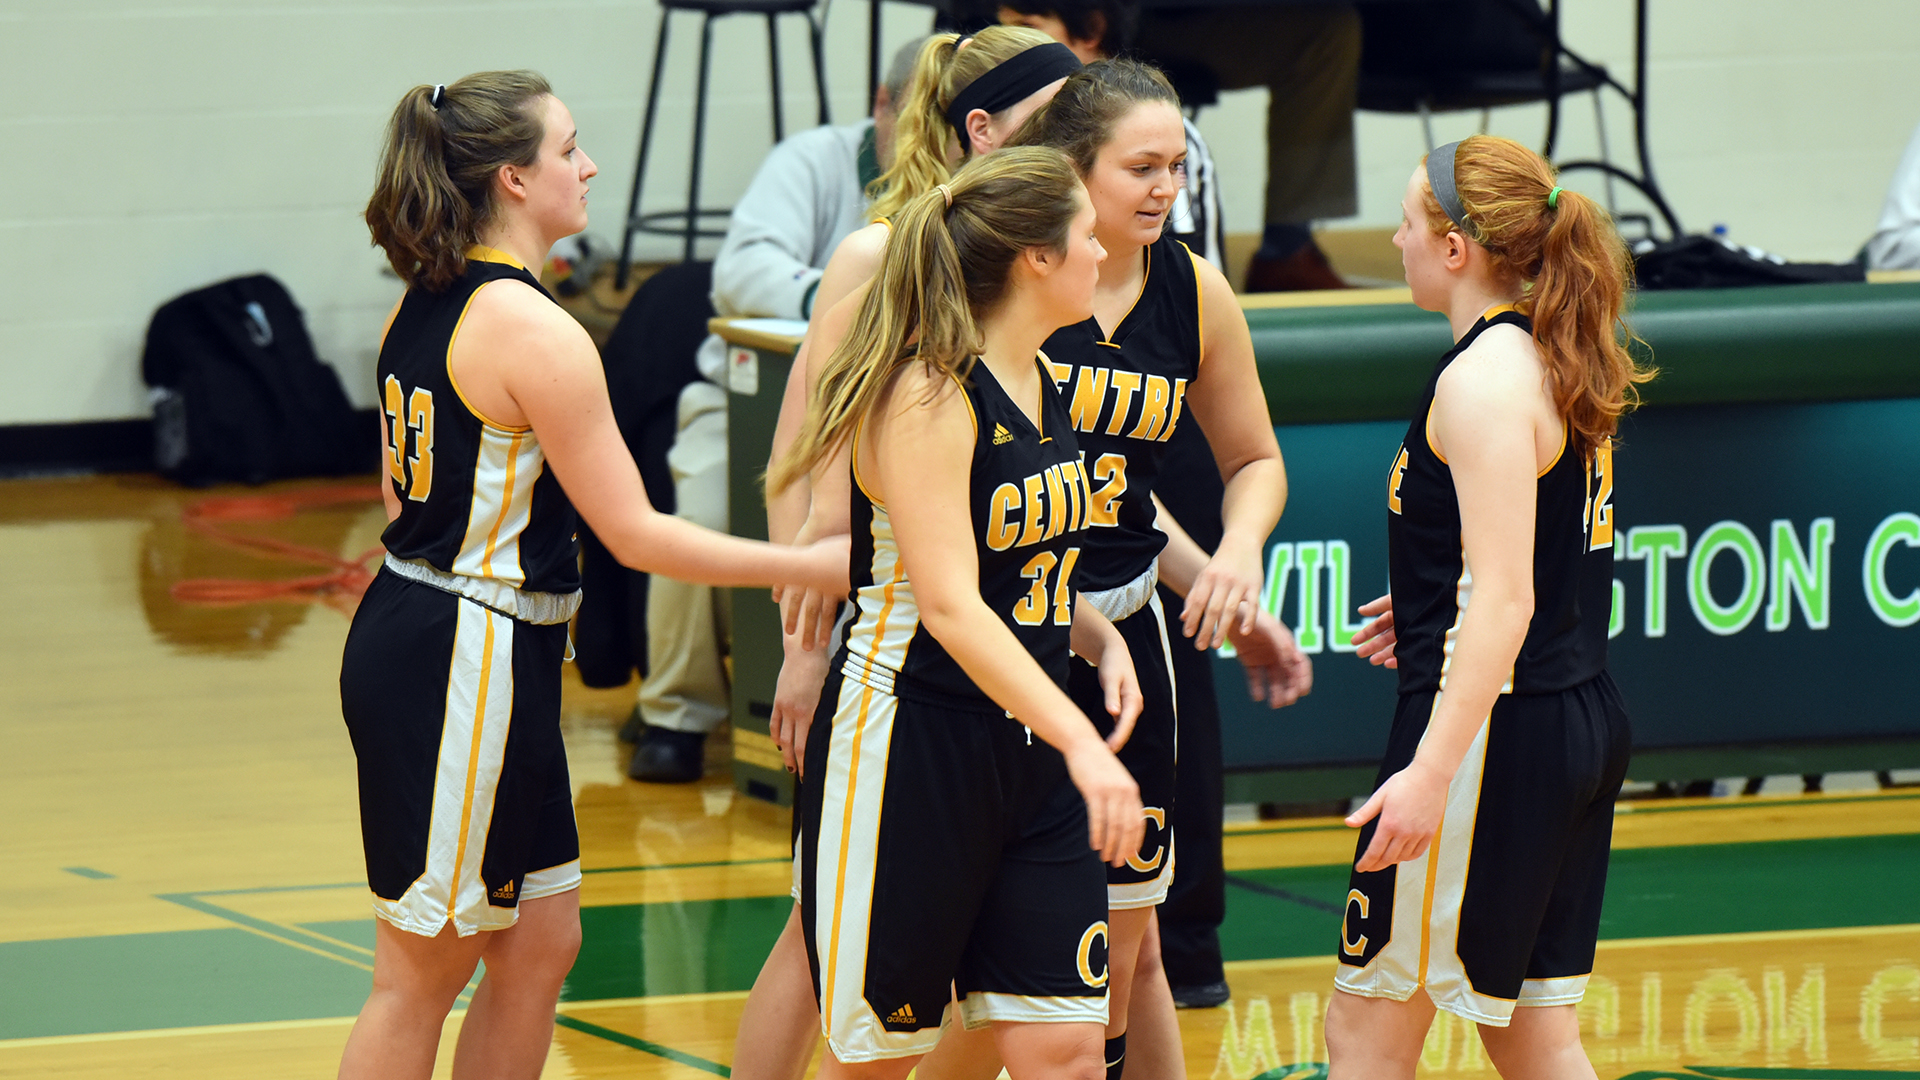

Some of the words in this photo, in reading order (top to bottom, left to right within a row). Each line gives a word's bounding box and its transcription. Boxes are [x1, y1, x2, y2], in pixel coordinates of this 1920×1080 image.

[385, 373, 435, 504] 33
[1078, 449, 1128, 528] 2
[1076, 920, 1109, 988] C
[1341, 888, 1370, 957] C
[886, 1014, 917, 1025] adidas
